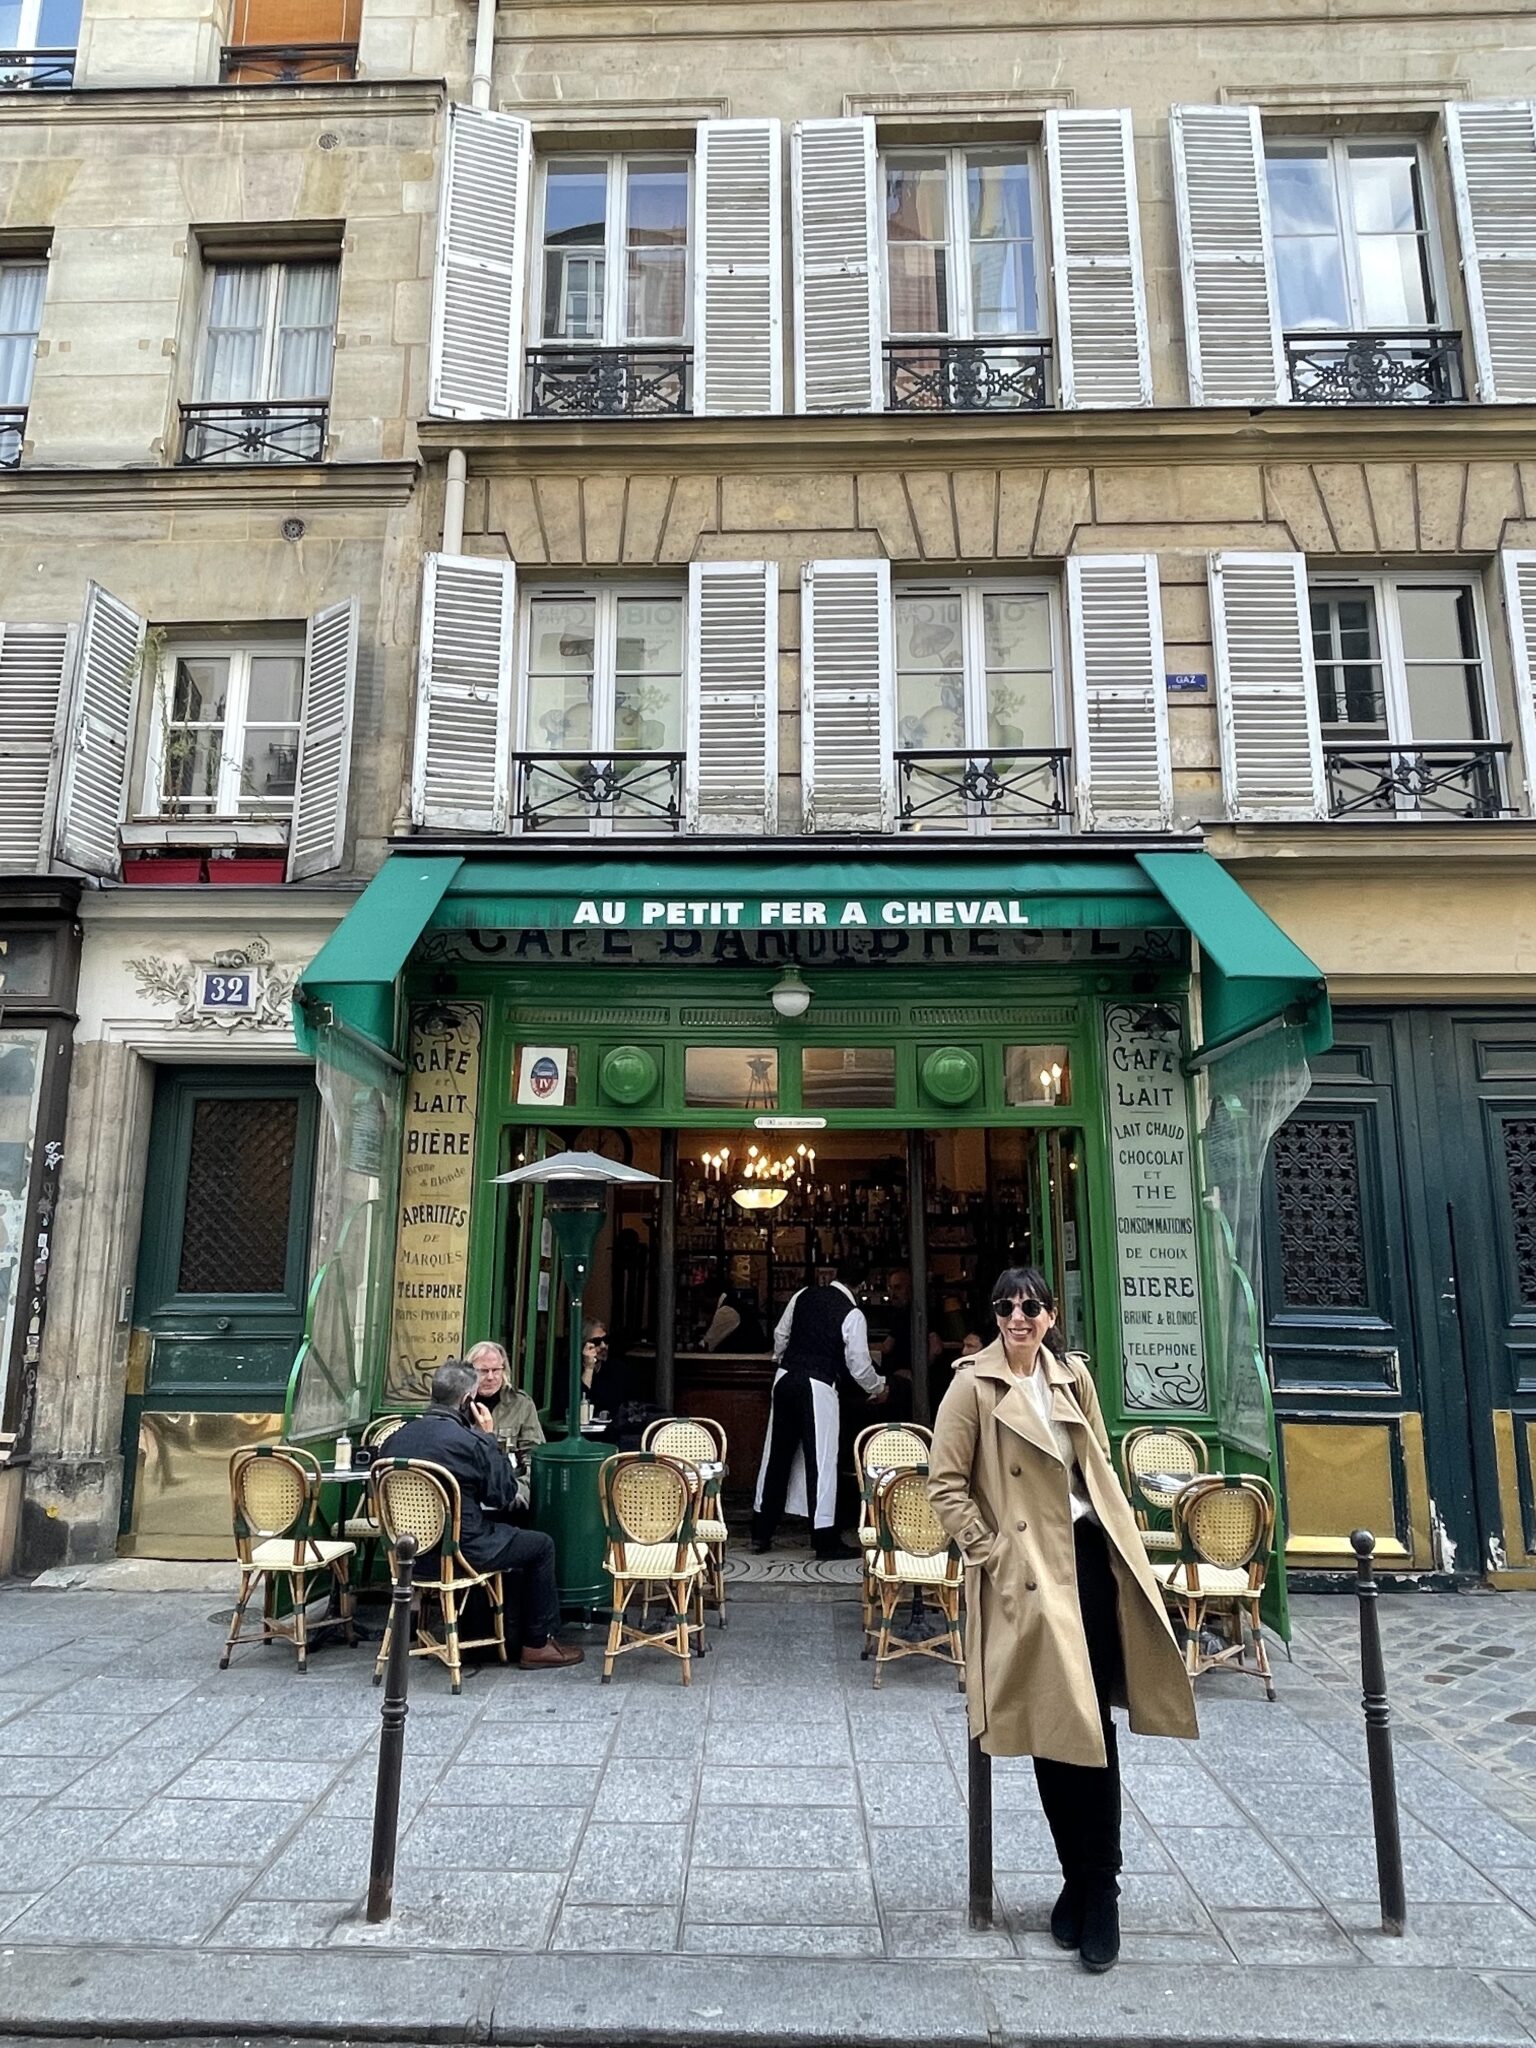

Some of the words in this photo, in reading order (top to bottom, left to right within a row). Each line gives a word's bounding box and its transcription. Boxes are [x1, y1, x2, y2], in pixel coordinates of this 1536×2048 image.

[572, 901, 626, 924] AU
[642, 902, 744, 925] PETIT
[760, 902, 827, 925] FER
[839, 902, 868, 925] A
[881, 901, 1029, 925] CHEVAL
[211, 977, 243, 1002] 32
[415, 1048, 471, 1075] CAFÉ
[413, 1091, 467, 1113] LAIT
[1117, 1083, 1173, 1106] LAIT
[1114, 1123, 1141, 1140] LAIT
[1146, 1121, 1185, 1140] CHAUD
[407, 1128, 470, 1155] BIÈRE
[1119, 1150, 1184, 1165] CHOCOLAT
[430, 1167, 466, 1187] Blonde
[1144, 1171, 1161, 1179] ET
[1118, 1217, 1192, 1234] CONSOMMATIONS
[423, 1234, 440, 1243] DE
[402, 1250, 463, 1267] MARQUES
[1126, 1248, 1142, 1259] DE
[1149, 1247, 1188, 1259] CHOIX
[1122, 1277, 1194, 1297] BIERE
[1124, 1310, 1153, 1325] BRUNE
[1157, 1313, 1164, 1325] &
[1166, 1311, 1199, 1325] BLONDE
[1128, 1343, 1197, 1356] TELEPHONE
